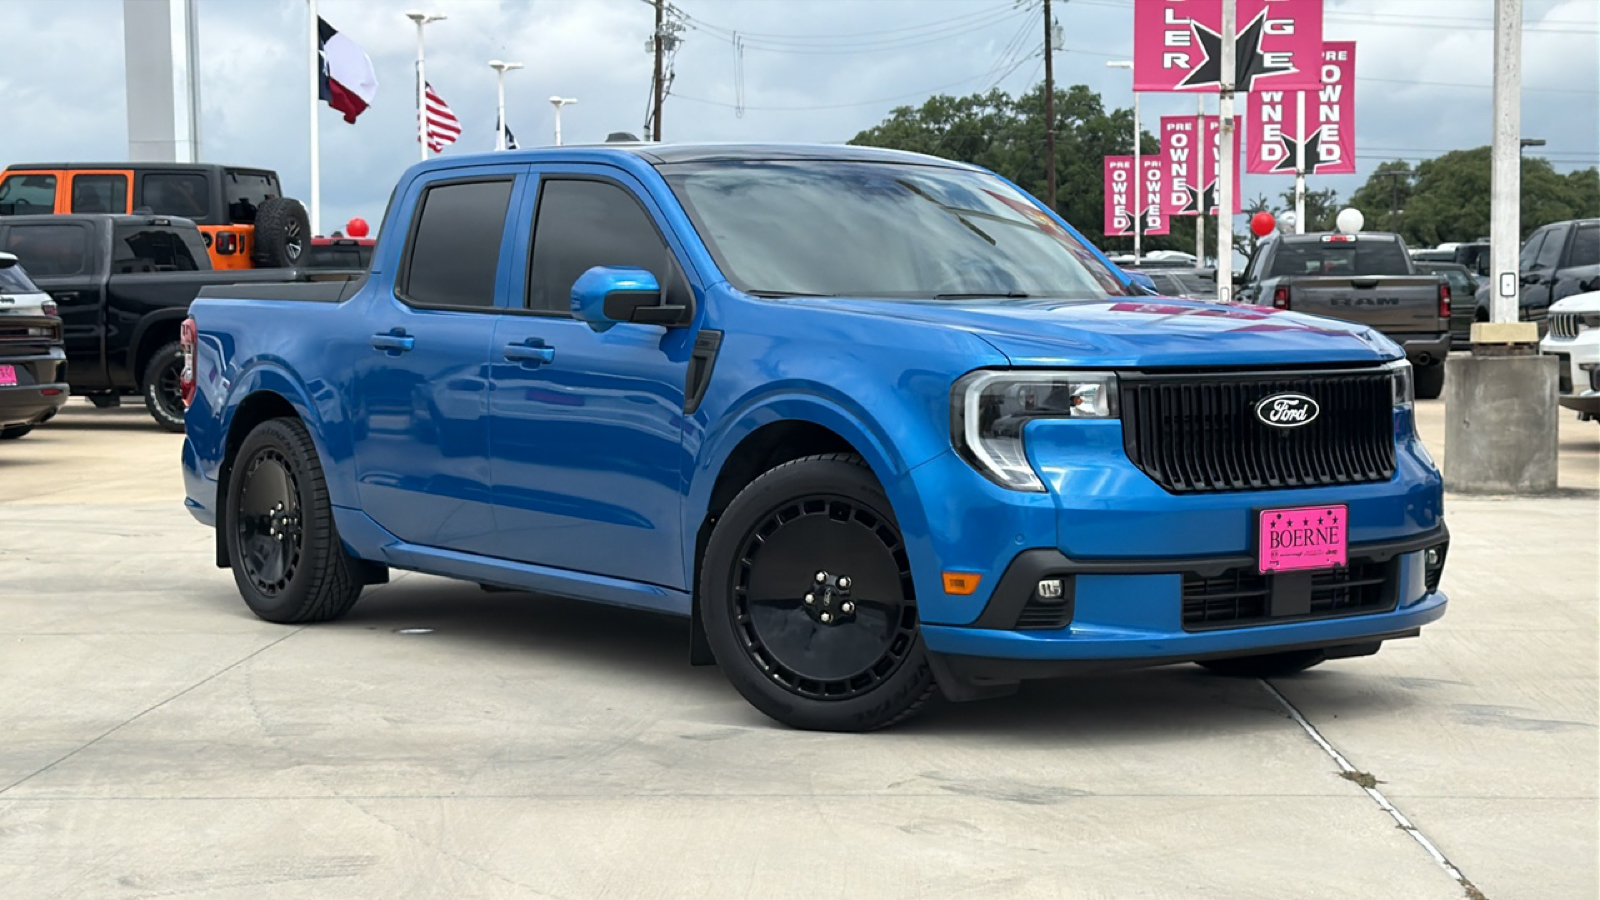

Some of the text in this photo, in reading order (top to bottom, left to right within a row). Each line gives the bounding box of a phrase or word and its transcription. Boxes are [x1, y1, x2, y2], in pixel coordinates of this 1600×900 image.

[1164, 0, 1191, 69] LER
[1263, 0, 1295, 68] GE
[1166, 122, 1193, 131] PRE
[1261, 91, 1283, 161] WNED
[1319, 64, 1342, 161] OWNED
[1112, 169, 1127, 228] OWNED
[1170, 133, 1189, 205] OWNED
[1330, 297, 1400, 306] RAM
[1270, 399, 1309, 422] Ford
[1270, 526, 1339, 549] BOERNE
